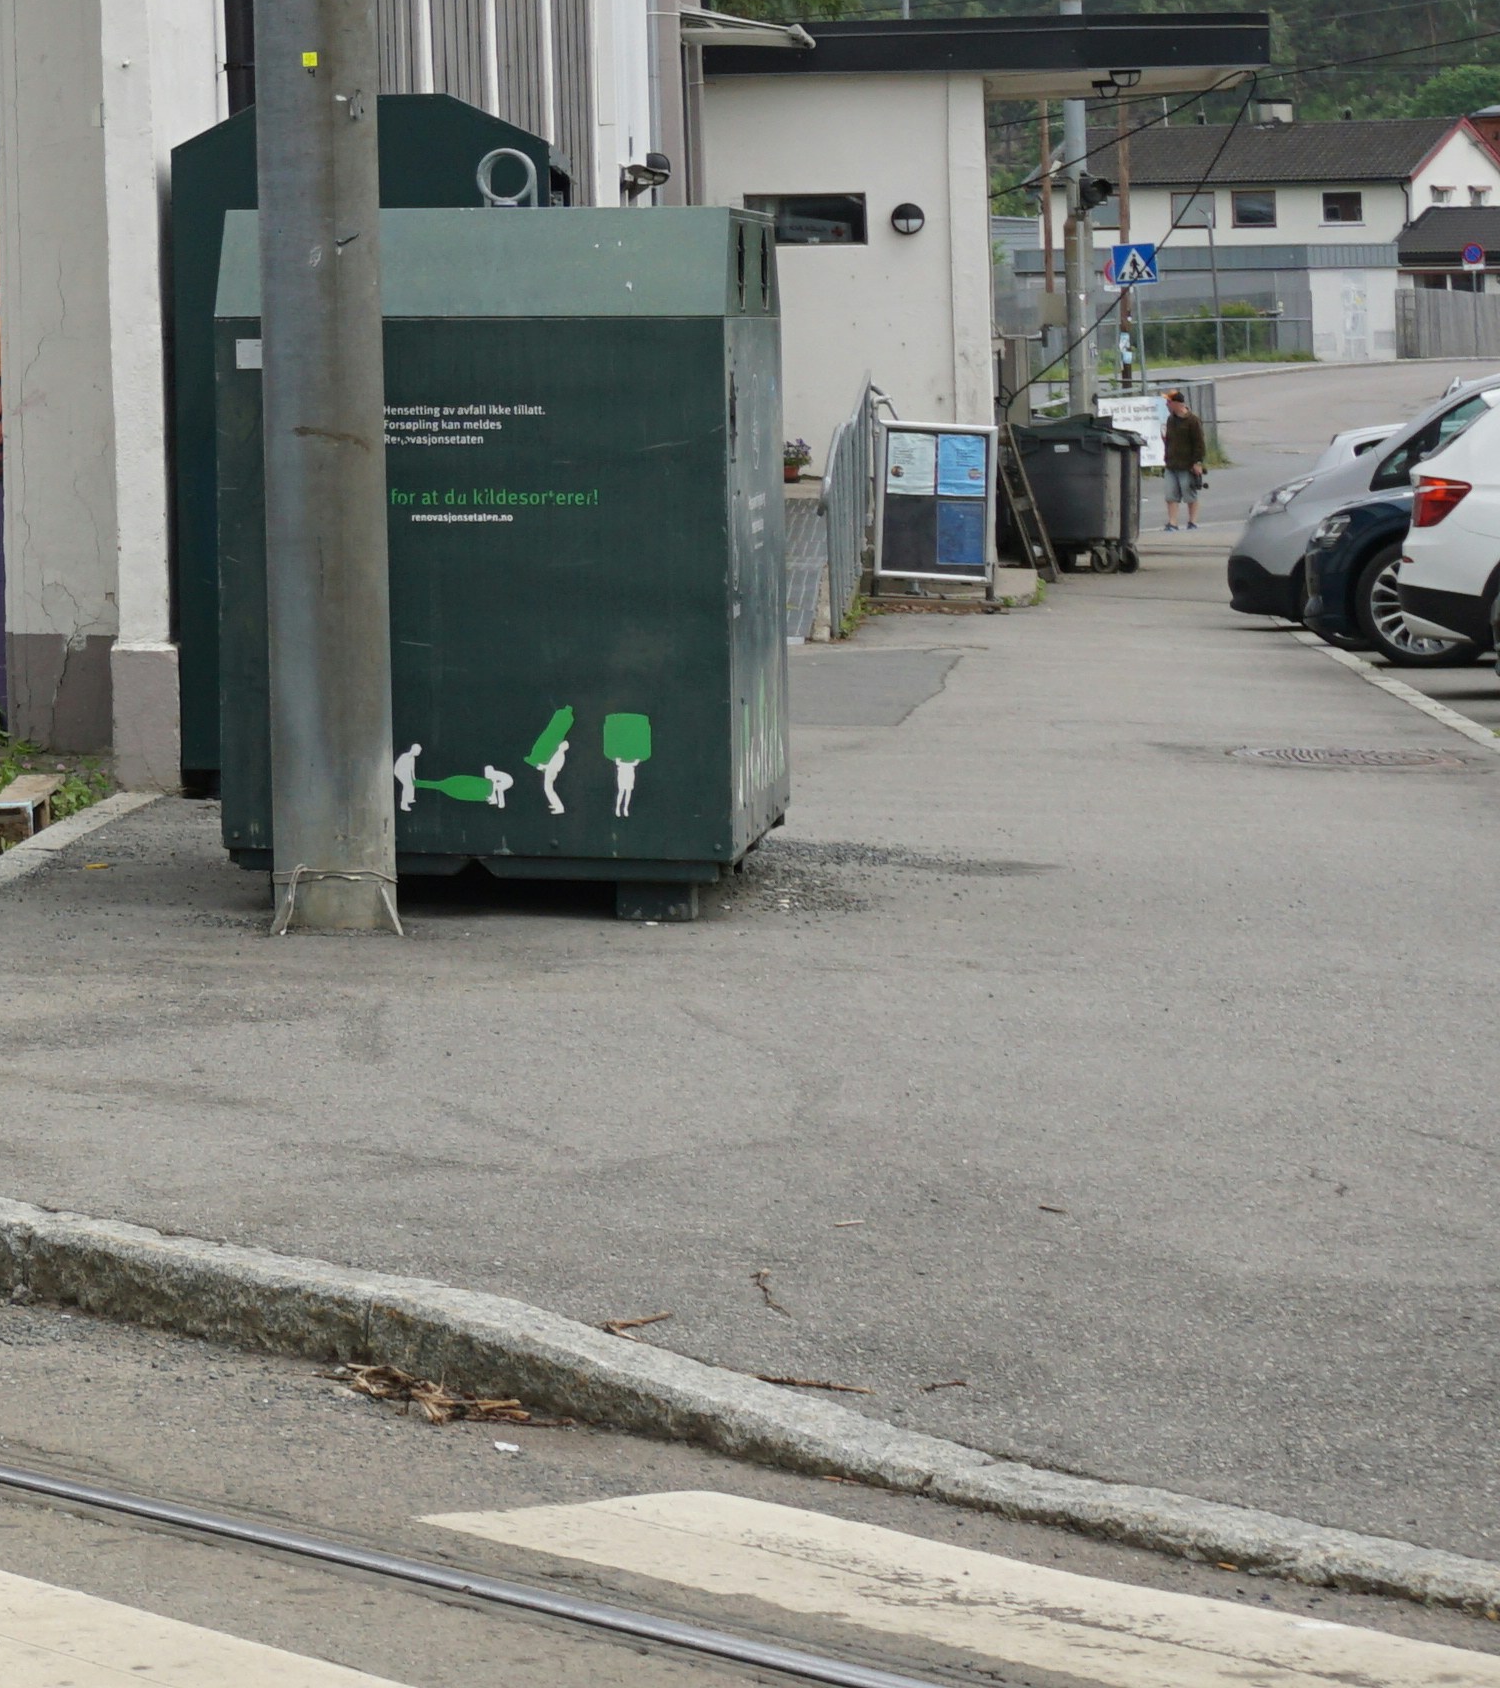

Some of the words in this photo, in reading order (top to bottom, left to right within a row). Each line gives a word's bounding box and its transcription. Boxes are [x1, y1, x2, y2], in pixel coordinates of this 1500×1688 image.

[383, 404, 441, 417] Hensetting
[442, 407, 456, 416] av
[457, 404, 487, 416] avfall
[488, 404, 511, 416] ikke
[513, 404, 546, 416] tillatt.
[383, 419, 439, 431] Forsøpling
[441, 419, 461, 430] kan
[463, 419, 502, 430] meldes
[391, 487, 416, 506] for
[421, 490, 439, 506] at
[444, 487, 467, 506] du
